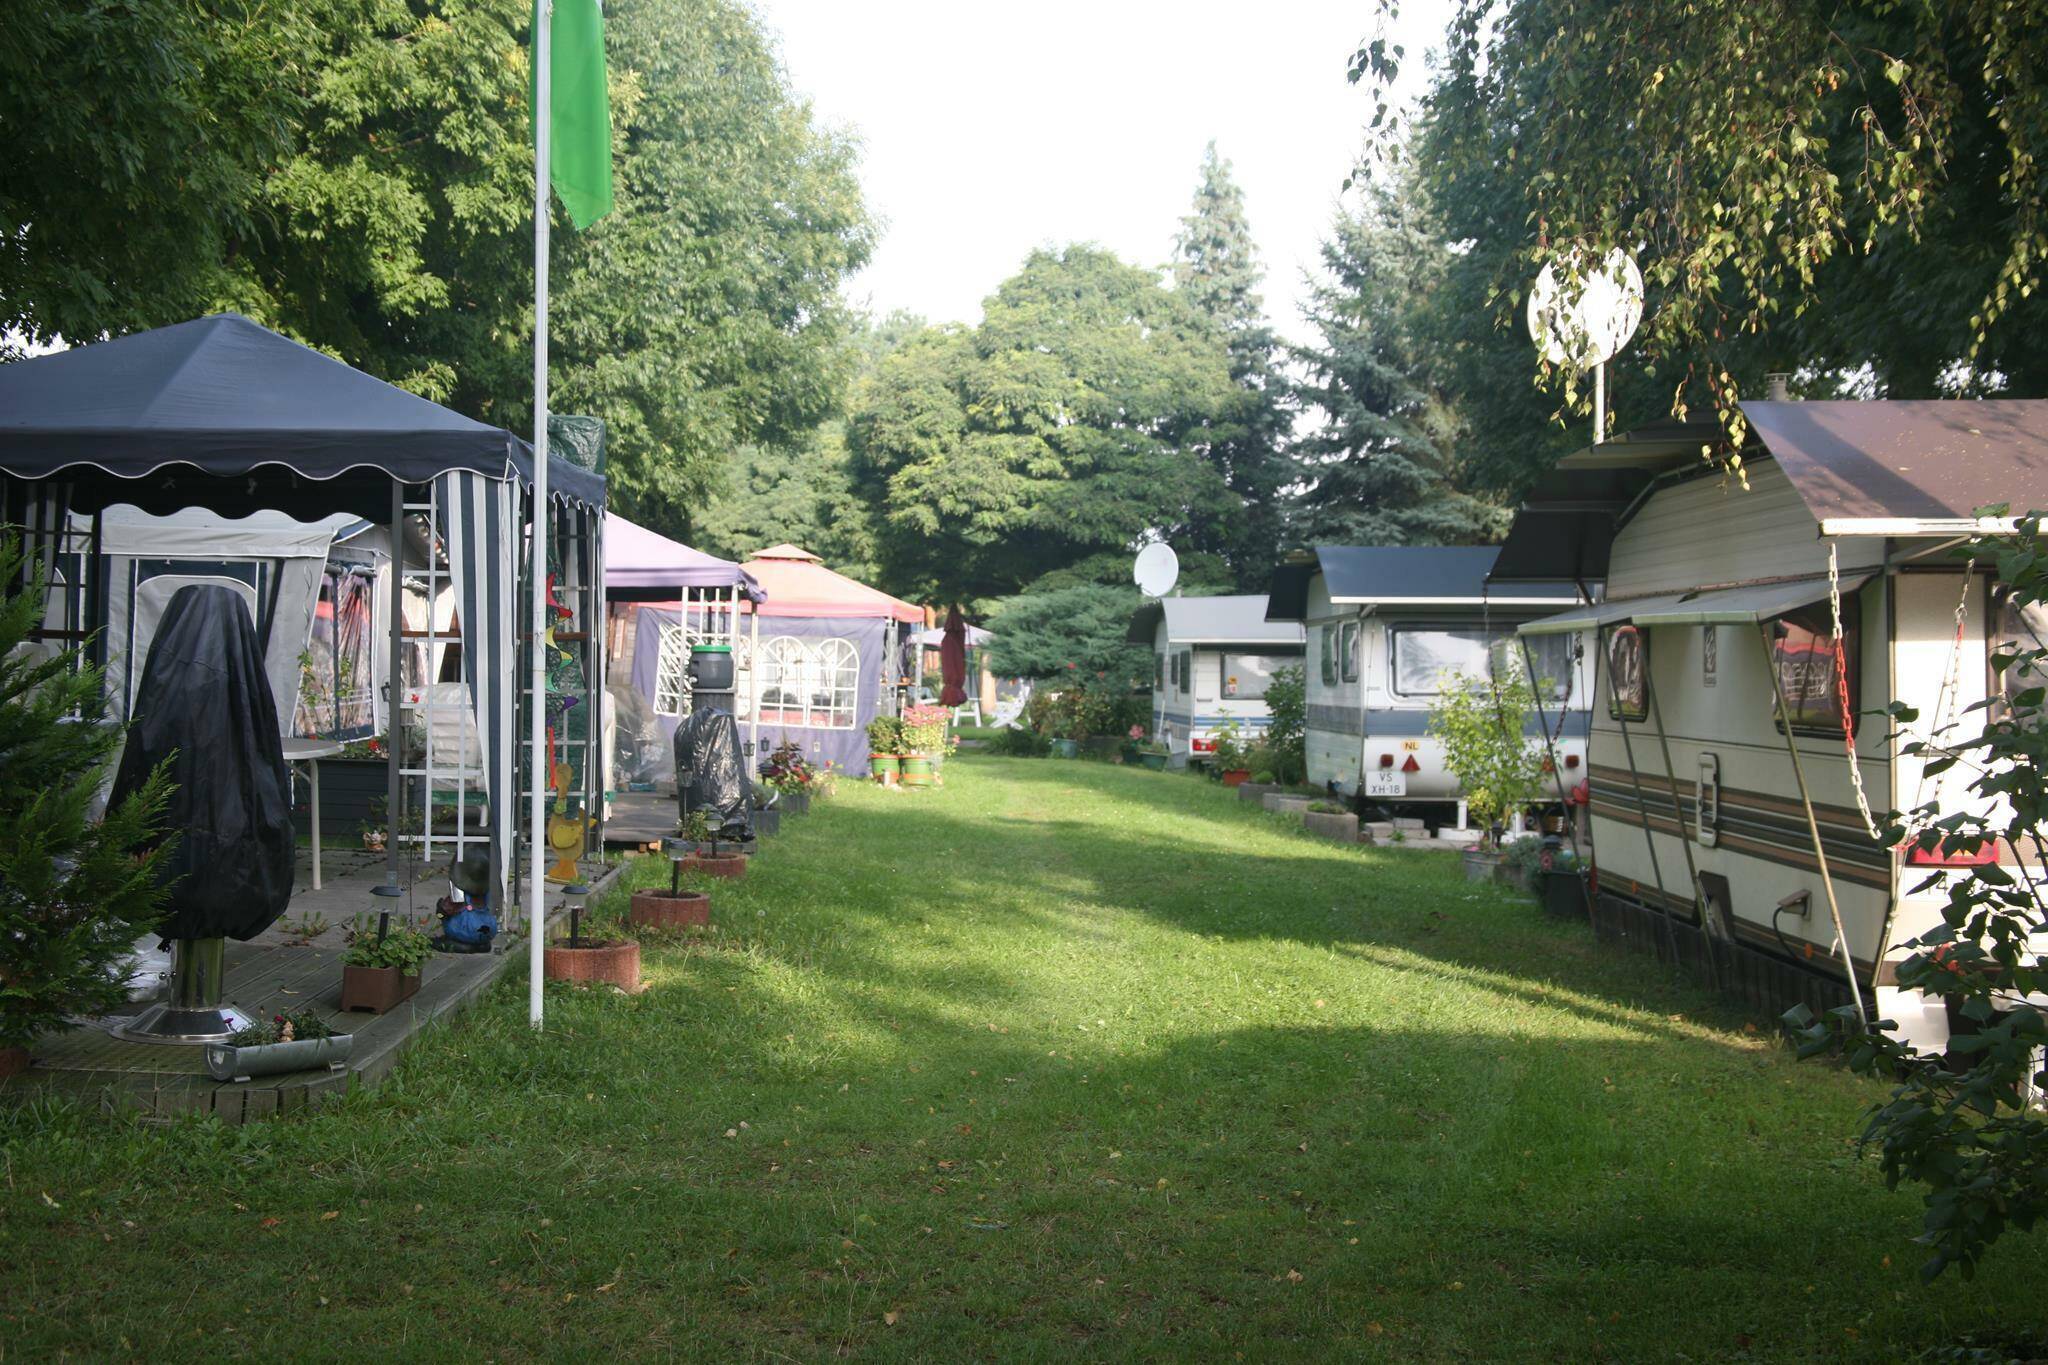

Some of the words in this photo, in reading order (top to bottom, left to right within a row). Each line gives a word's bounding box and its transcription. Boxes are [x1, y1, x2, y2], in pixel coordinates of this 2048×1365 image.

[1405, 742, 1418, 750] NL
[1379, 772, 1393, 782] VS
[1371, 785, 1400, 794] XH-18
